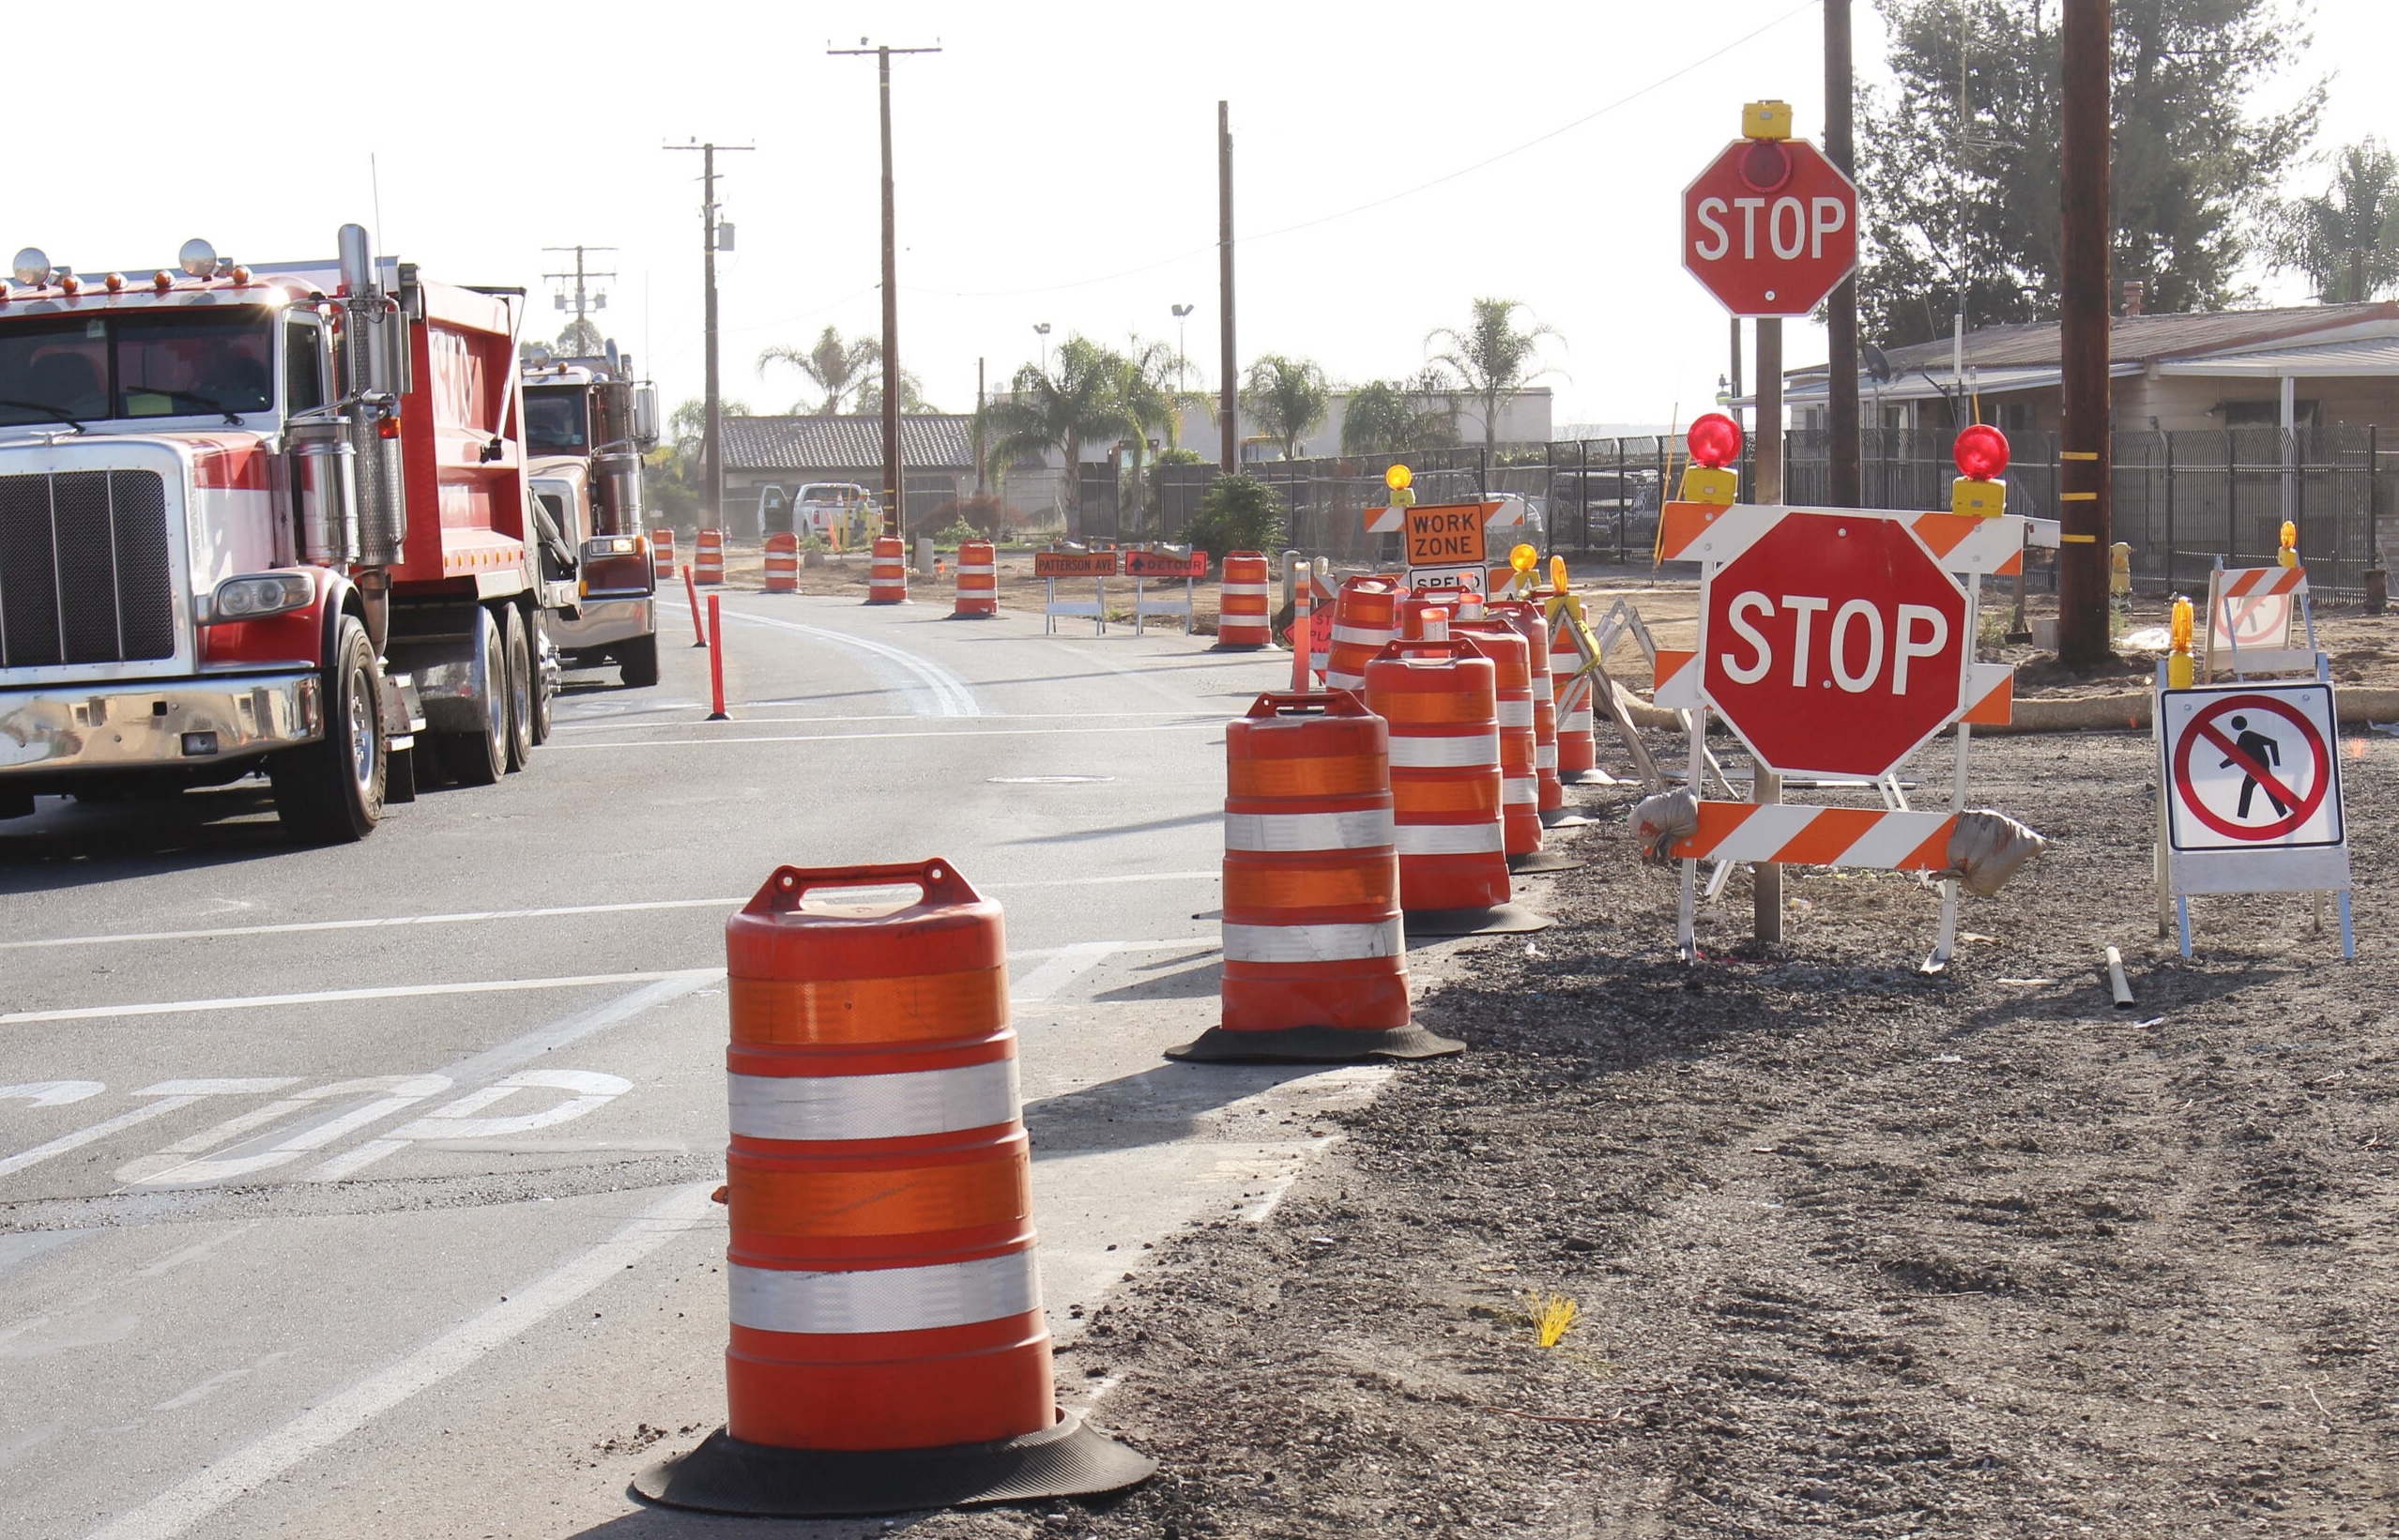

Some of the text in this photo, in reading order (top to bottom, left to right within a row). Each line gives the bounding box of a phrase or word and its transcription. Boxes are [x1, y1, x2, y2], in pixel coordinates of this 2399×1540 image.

[1695, 196, 1846, 261] STOP
[1413, 513, 1475, 534] WORK
[1414, 536, 1473, 557] ZONE
[1038, 558, 1113, 572] PATTERSON AVE
[1147, 559, 1201, 571] DETOUR
[1721, 590, 1948, 695] STOP
[0, 1069, 634, 1184] TOP
